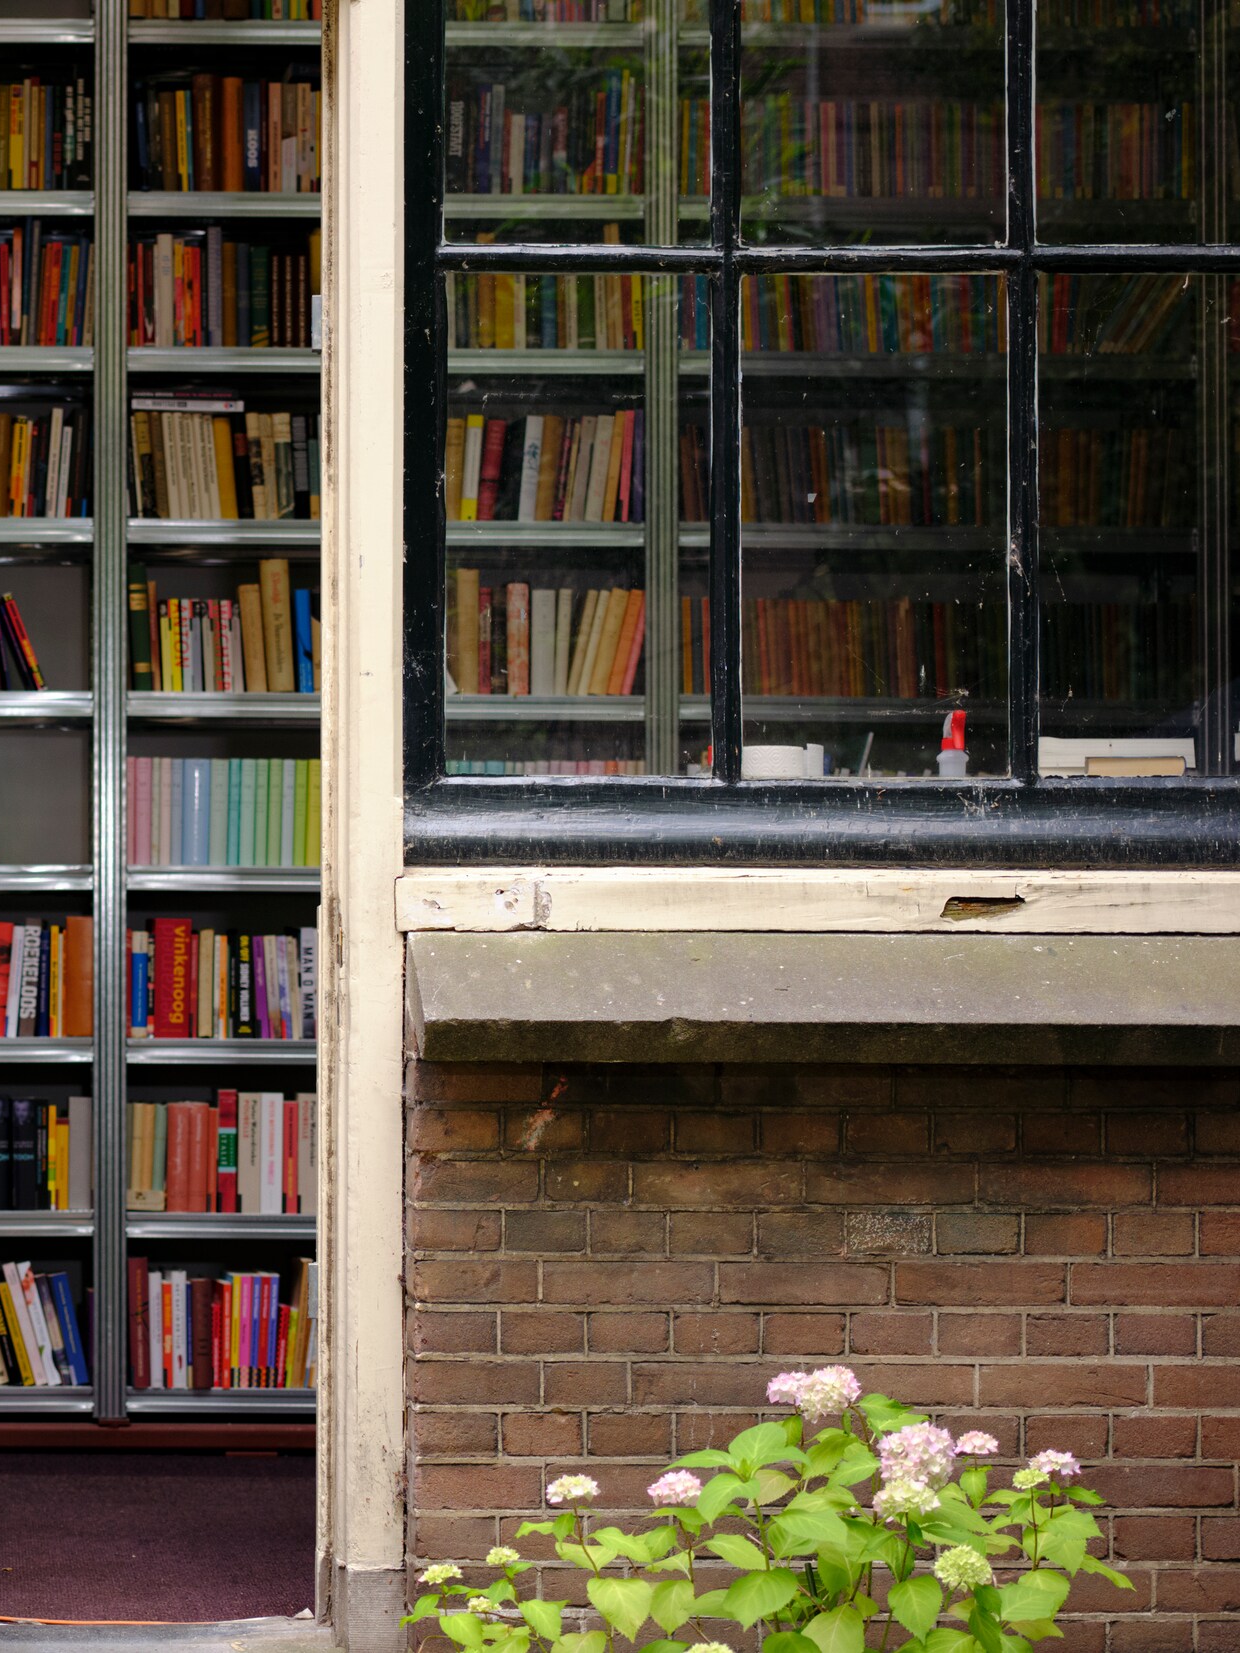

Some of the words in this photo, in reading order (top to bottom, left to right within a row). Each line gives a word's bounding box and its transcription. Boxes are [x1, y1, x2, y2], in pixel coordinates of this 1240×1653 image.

[246, 129, 258, 168] KOOS
[173, 603, 190, 668] ANTON
[213, 604, 232, 691] WACHTER
[20, 926, 42, 1019] ROEKELOOS
[169, 926, 190, 1024] vinkenoog
[303, 947, 313, 973] MAN
[304, 993, 314, 1019] MAN
